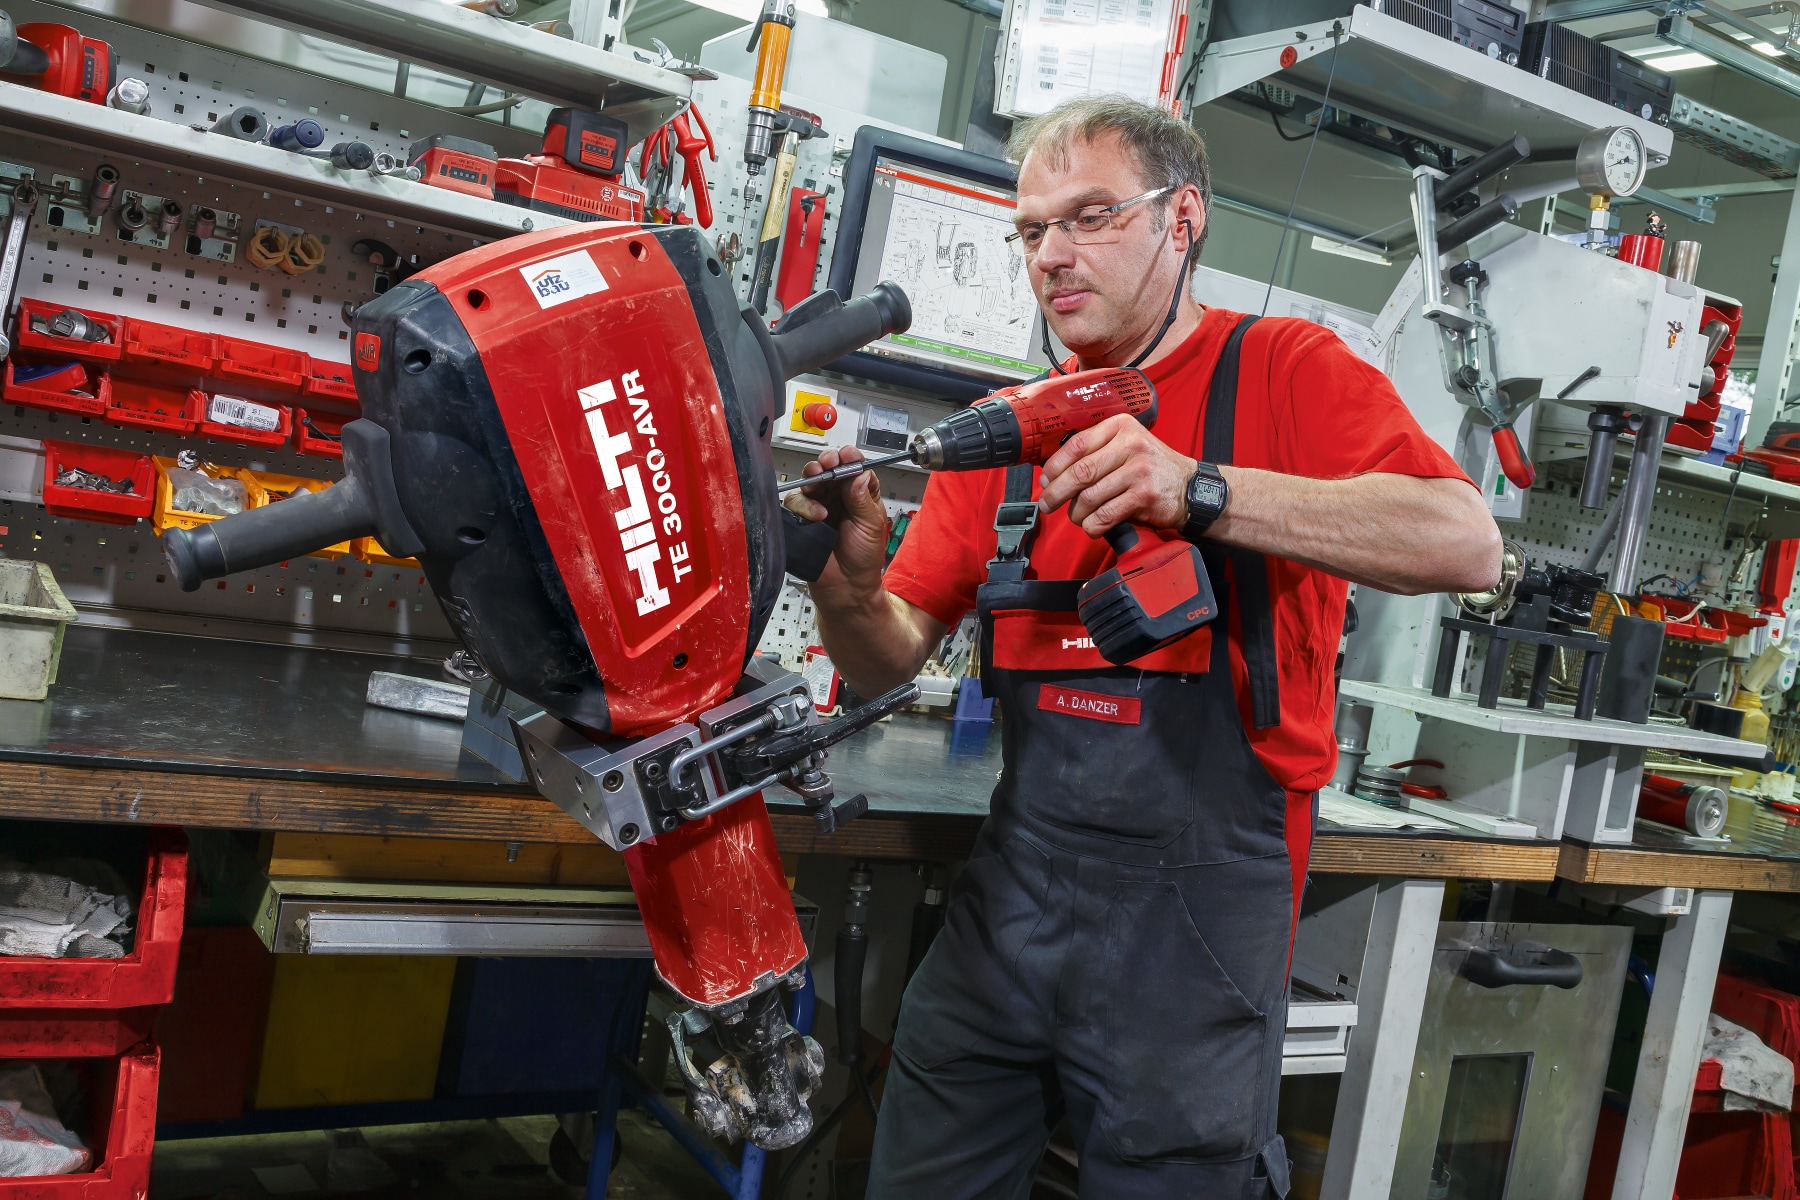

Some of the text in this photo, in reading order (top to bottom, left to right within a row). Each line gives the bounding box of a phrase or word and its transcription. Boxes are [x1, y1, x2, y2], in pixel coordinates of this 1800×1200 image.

[536, 281, 570, 298] bau
[537, 274, 563, 288] utz
[1065, 381, 1108, 398] HILTI
[621, 369, 692, 583] TE 3000-AVR
[577, 379, 671, 616] HILTI
[1187, 606, 1210, 621] CPC
